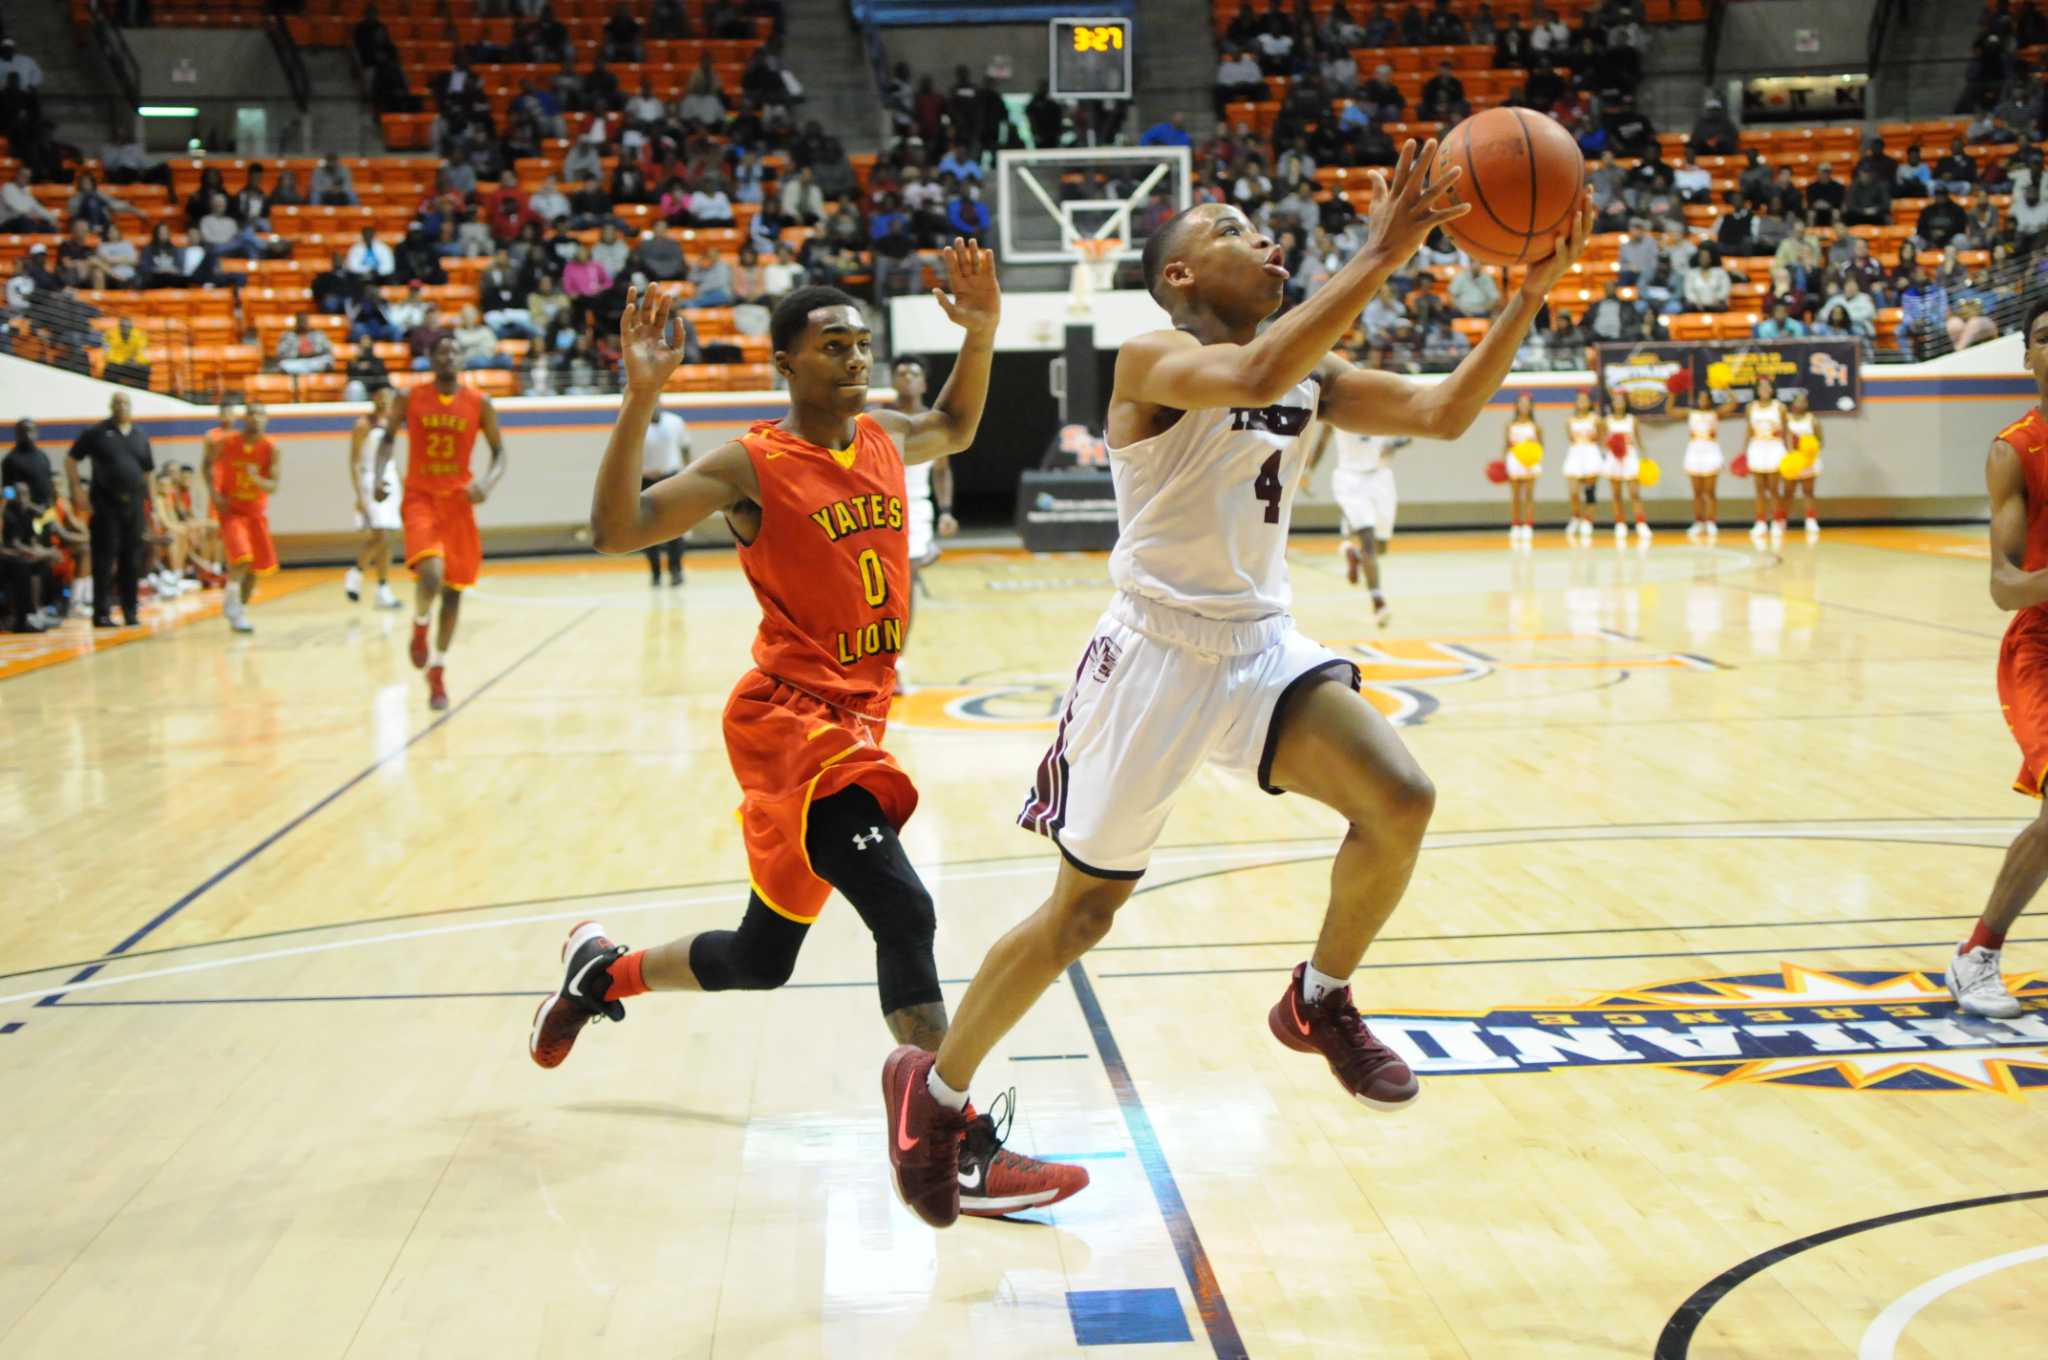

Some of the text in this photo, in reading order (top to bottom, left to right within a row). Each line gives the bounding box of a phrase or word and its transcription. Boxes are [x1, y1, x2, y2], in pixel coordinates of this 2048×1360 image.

[1073, 26, 1123, 52] 3:27
[426, 432, 456, 459] 23
[1254, 449, 1283, 524] 4
[809, 494, 905, 542] YATES
[857, 548, 890, 609] 0
[837, 617, 904, 666] LION
